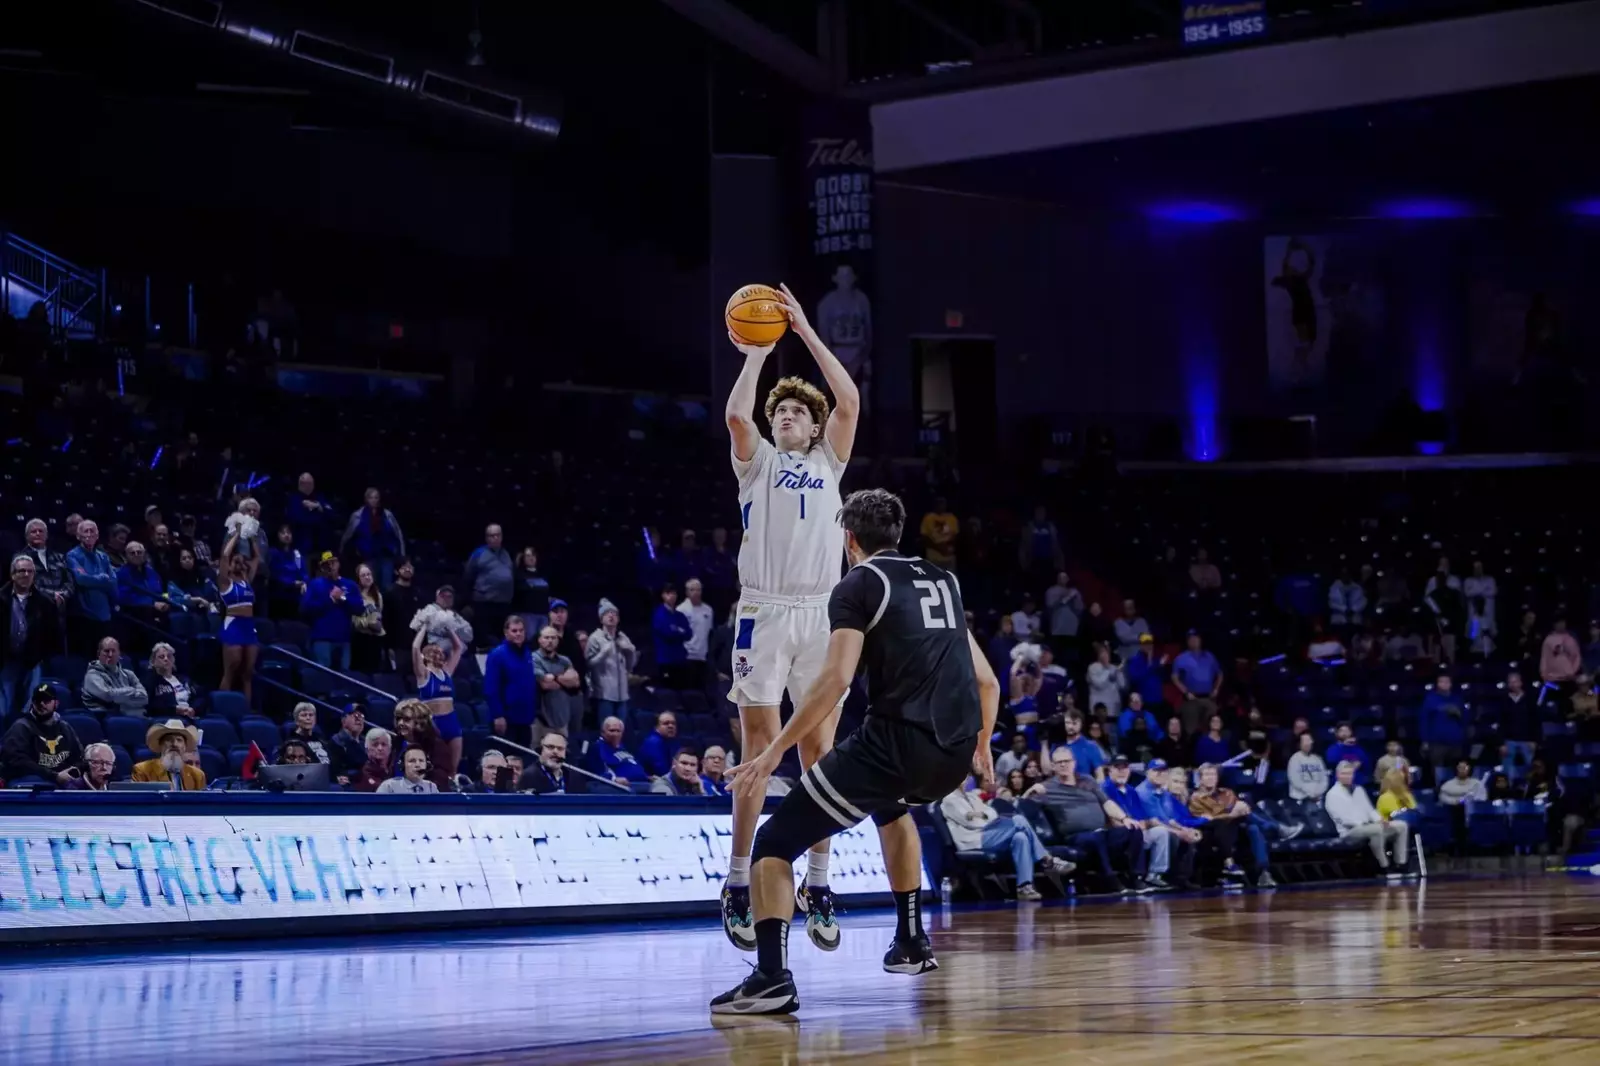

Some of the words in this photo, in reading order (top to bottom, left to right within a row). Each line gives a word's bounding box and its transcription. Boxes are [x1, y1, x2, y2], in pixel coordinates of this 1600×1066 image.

[1184, 16, 1264, 42] 1954-1955
[773, 470, 825, 490] Tulsa
[800, 493, 805, 520] 1
[912, 579, 957, 629] 21
